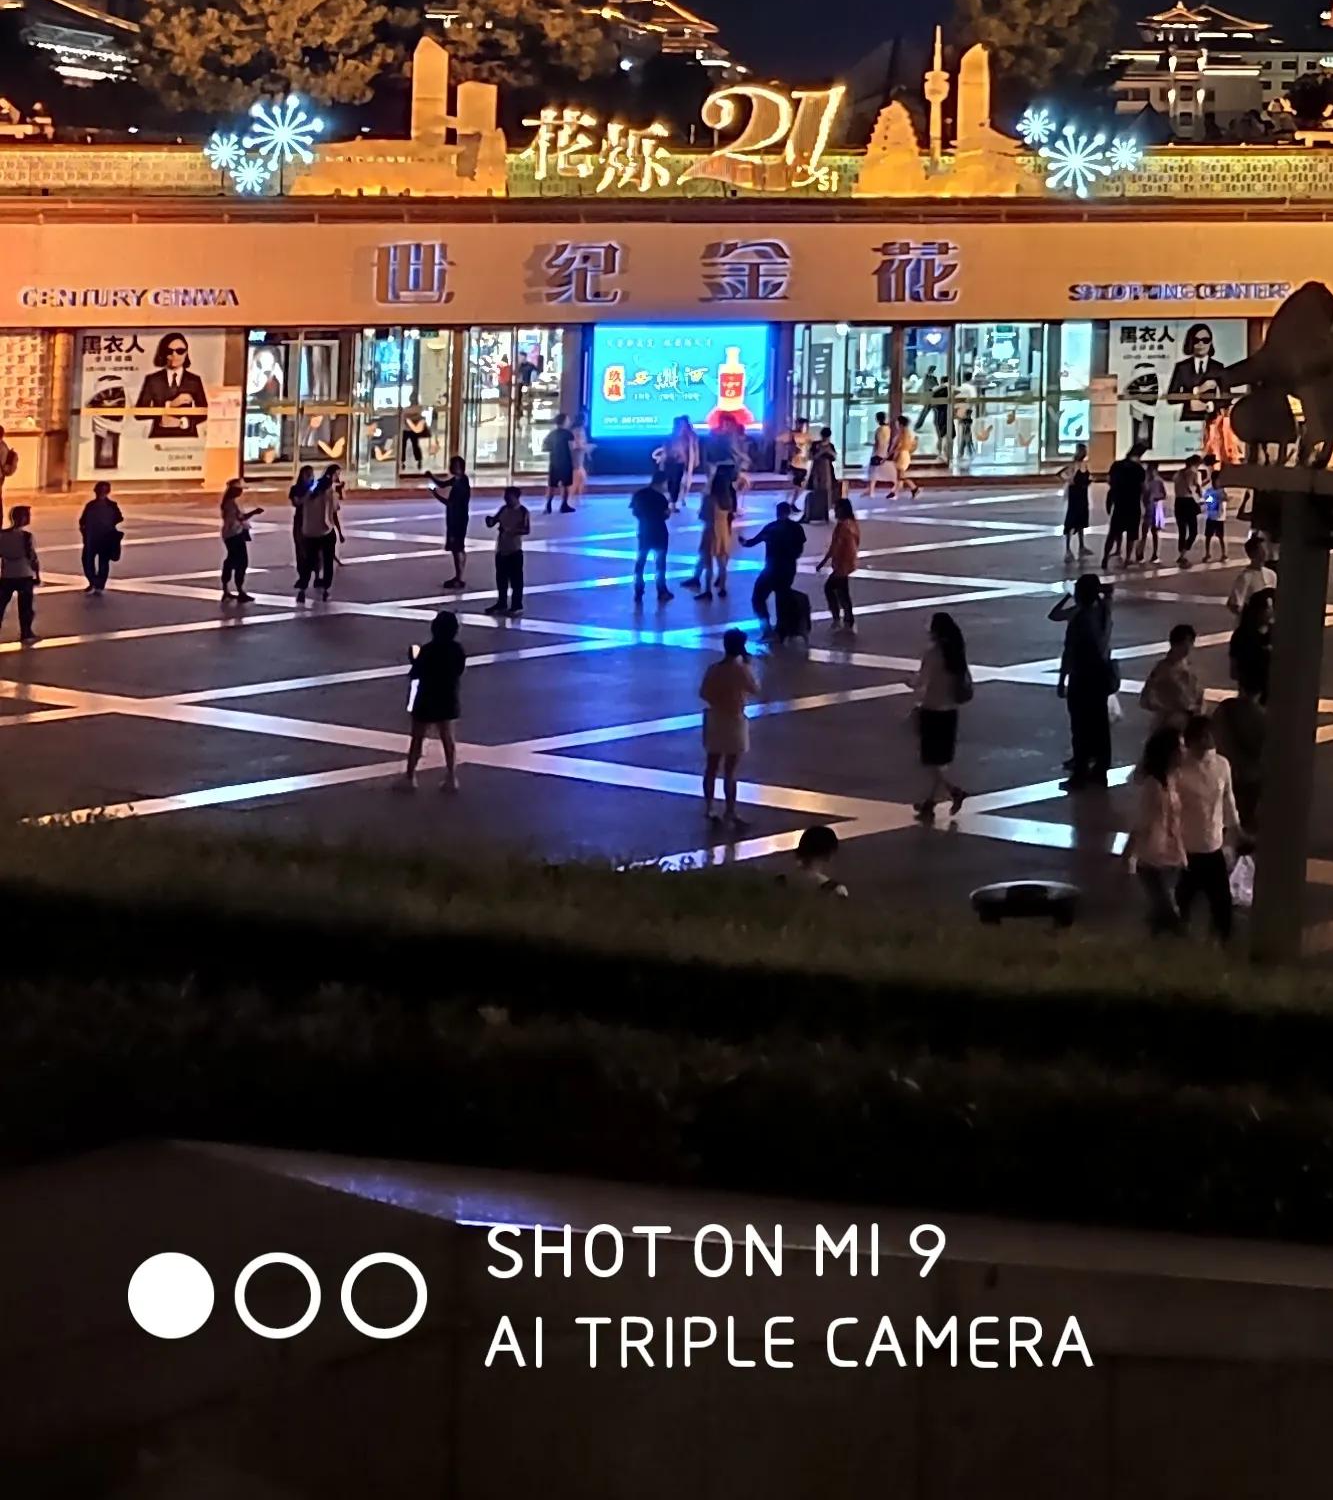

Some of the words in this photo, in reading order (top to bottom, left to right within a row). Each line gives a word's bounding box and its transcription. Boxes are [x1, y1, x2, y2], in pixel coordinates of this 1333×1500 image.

[371, 240, 960, 305] 世纪金花
[21, 288, 149, 308] CENTURY
[82, 334, 145, 355] 黑衣人
[1120, 325, 1175, 344] 黑衣人
